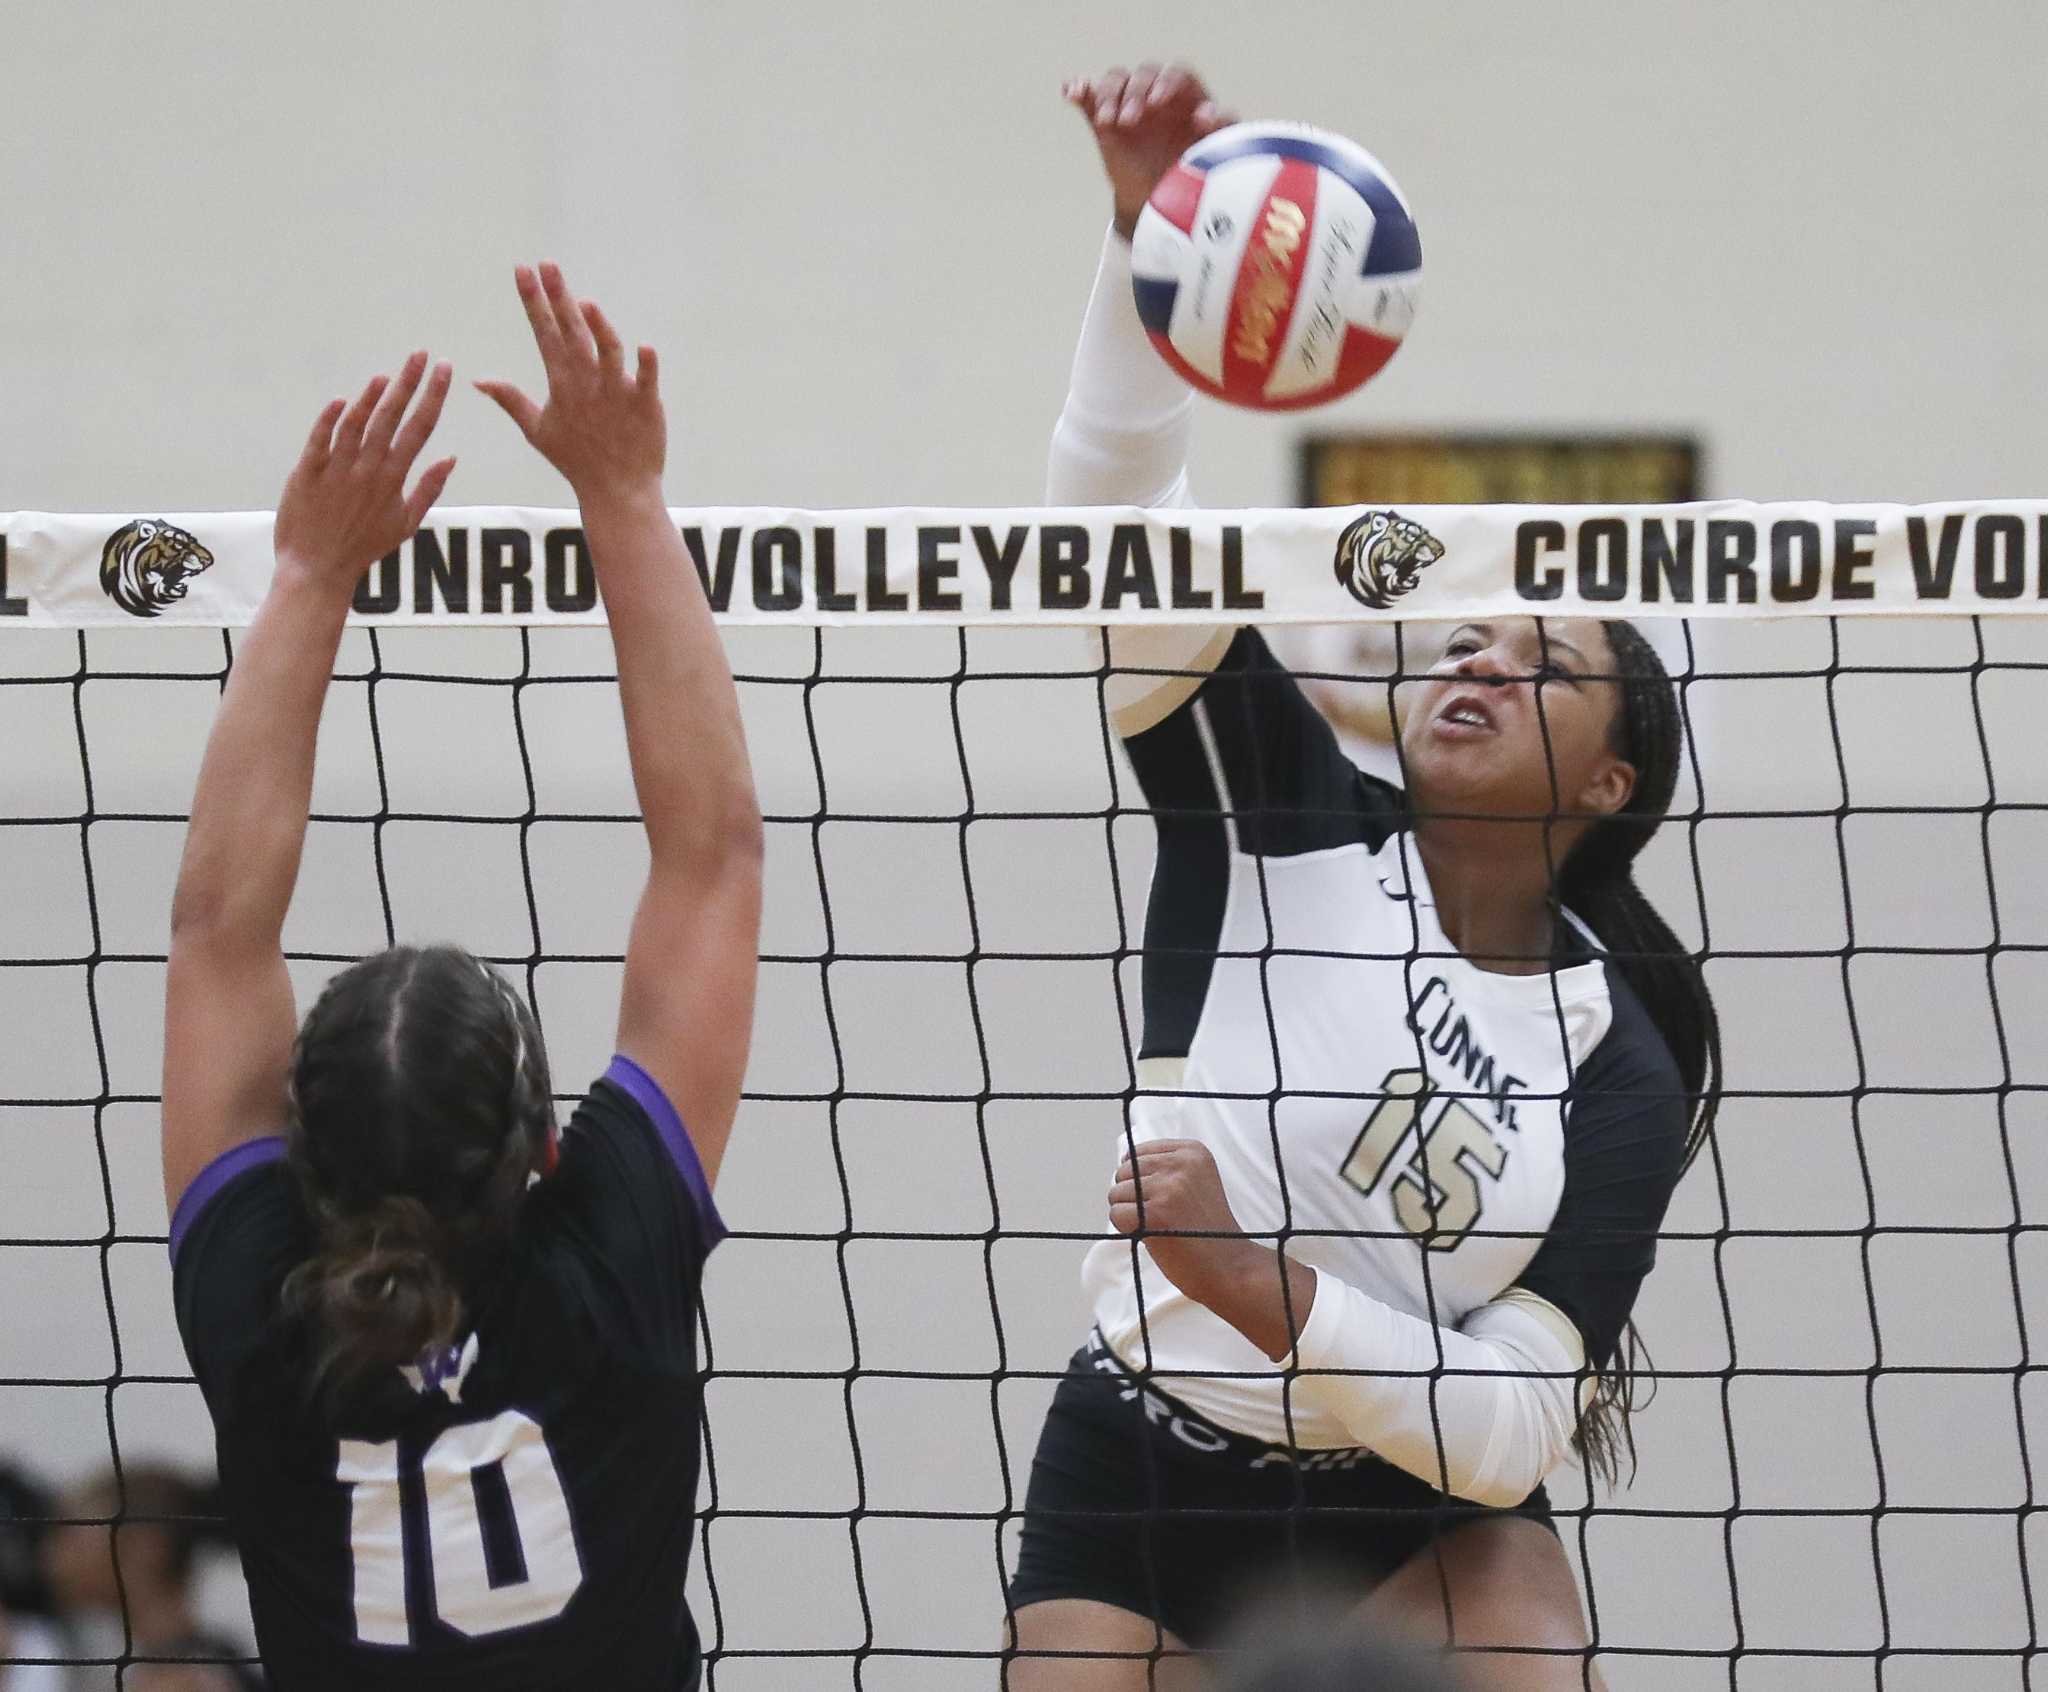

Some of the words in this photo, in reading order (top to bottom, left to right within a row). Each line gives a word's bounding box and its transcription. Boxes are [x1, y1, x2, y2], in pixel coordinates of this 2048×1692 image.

[352, 527, 597, 614] ONRO
[682, 524, 1265, 612] VOLLEYBALL
[1514, 518, 1877, 604] CONROE
[1339, 1067, 1508, 1252] 15
[336, 1409, 583, 1646] 10
